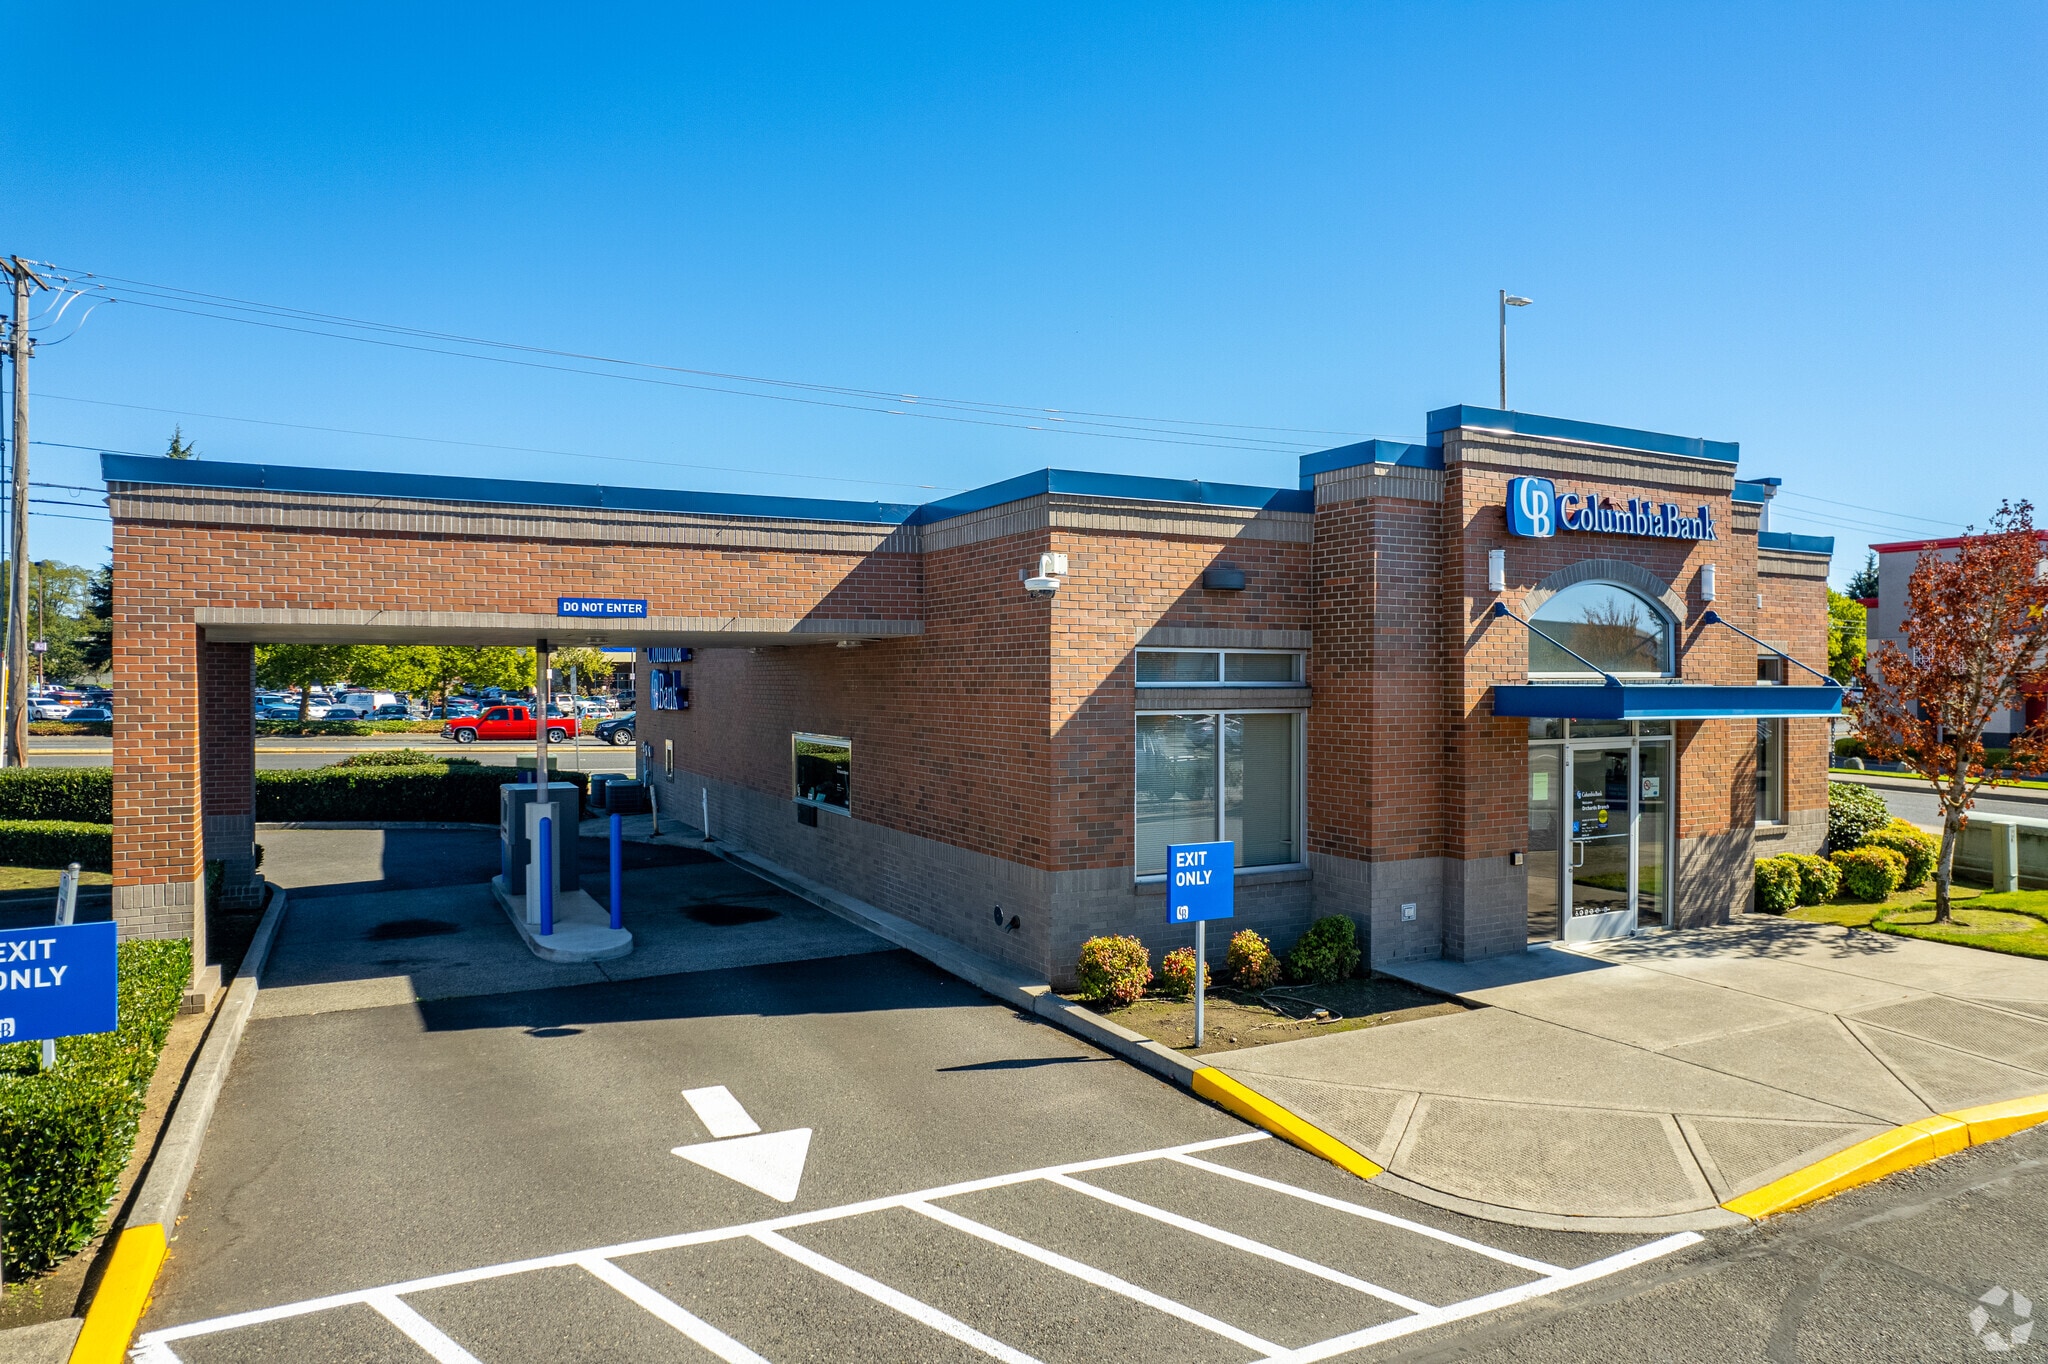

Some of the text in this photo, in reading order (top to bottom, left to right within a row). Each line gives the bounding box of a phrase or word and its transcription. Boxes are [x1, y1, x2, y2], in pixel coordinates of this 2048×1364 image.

[563, 602, 643, 613] DO NOT ENTER
[659, 671, 679, 710] Bank
[1176, 851, 1207, 867] EXIT
[1176, 870, 1212, 887] ONLY
